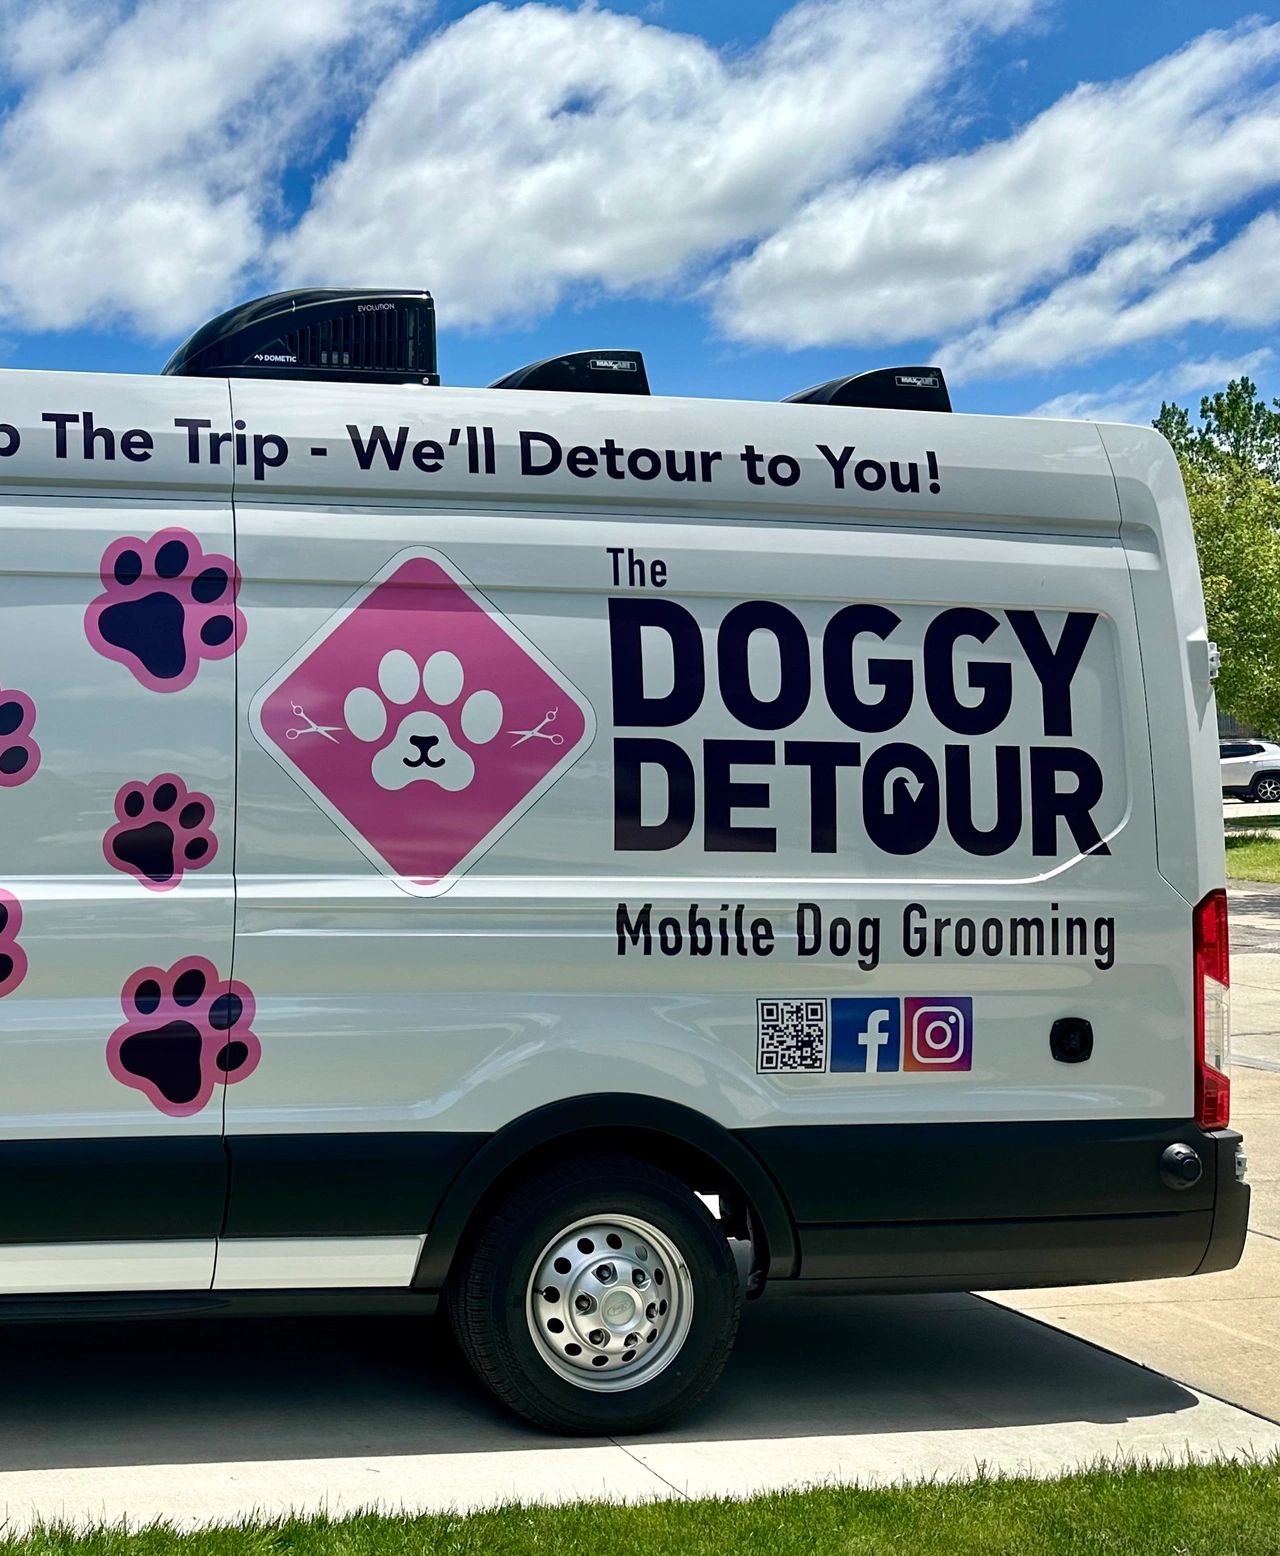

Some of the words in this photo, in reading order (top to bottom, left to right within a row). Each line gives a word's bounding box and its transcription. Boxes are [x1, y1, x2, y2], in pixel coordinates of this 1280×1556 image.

[357, 303, 395, 312] EVOLUTION
[264, 354, 297, 363] DOMETIC
[41, 411, 154, 463] The
[174, 418, 289, 481] Trip
[310, 447, 328, 457] -
[345, 425, 496, 475] We’ll
[519, 431, 723, 483] Detour
[740, 444, 801, 487] to
[815, 445, 941, 495] You!
[606, 547, 668, 588] The
[607, 597, 1101, 737] DOGGY
[613, 737, 1113, 857] DETOUR
[615, 902, 775, 958] Mobile
[796, 902, 881, 972] Dog
[902, 902, 1116, 971] Grooming
